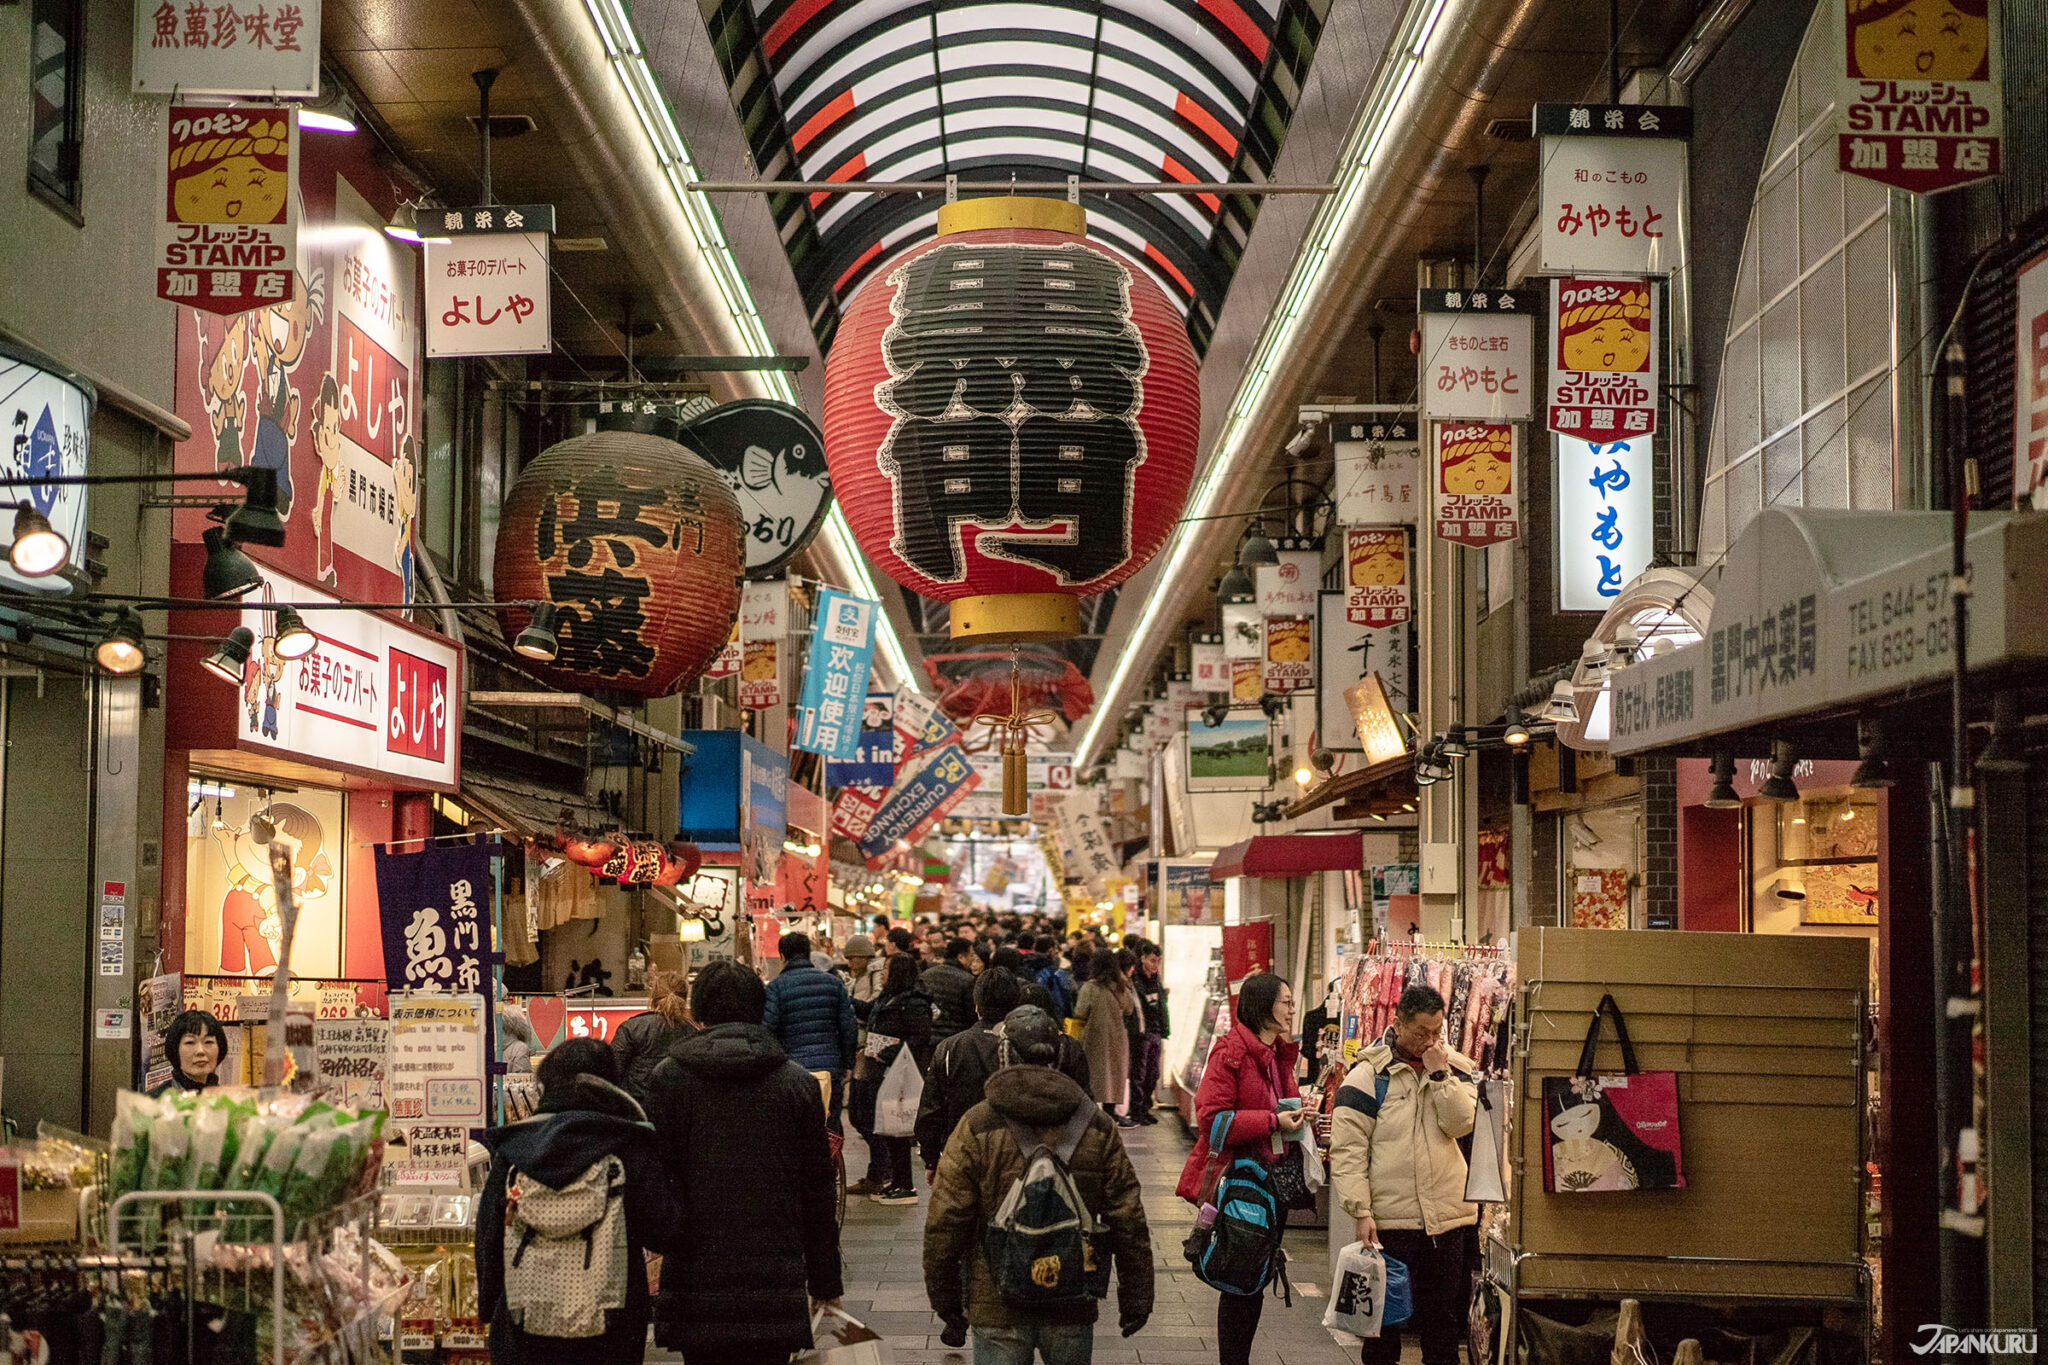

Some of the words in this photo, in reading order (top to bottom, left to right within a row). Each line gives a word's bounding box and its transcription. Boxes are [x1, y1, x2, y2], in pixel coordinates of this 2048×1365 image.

[151, 2, 304, 51] 魚萬珍味堂
[1860, 81, 1971, 103] フレッシュ
[172, 112, 249, 138] クロモン
[1849, 104, 1990, 134] STAMP
[1849, 139, 1991, 171] 加盟店
[1574, 168, 1647, 184] 和のこもの
[1556, 203, 1664, 238] みやもと
[177, 225, 272, 243] フレッシュ
[166, 244, 286, 267] STAMP
[446, 260, 527, 278] お菓子のデパート
[167, 272, 287, 298] 加盟店
[1561, 286, 1620, 304] クロモン
[442, 295, 535, 327] よしや
[1449, 336, 1508, 351] きものと宝石
[1438, 366, 1518, 394] みやもと
[1565, 372, 1638, 387] フレッシュ
[340, 336, 405, 458] よしや
[1557, 387, 1648, 404] STAMP
[1556, 408, 1647, 431] 加盟店
[1442, 429, 1489, 444] クロモン
[349, 469, 394, 526] 黒門市場店
[1447, 495, 1503, 506] フレッシュ
[1441, 506, 1512, 519] STAMP
[1351, 533, 1386, 546] クロモン
[1441, 521, 1513, 537] 加盟店
[1350, 595, 1405, 606] STAMP
[1848, 598, 1877, 634] TEL
[1881, 562, 1973, 626] 644-57
[1350, 609, 1407, 620] 加盟店
[1711, 593, 1817, 705] 黒門中央薬局
[1849, 638, 1877, 678] FAX
[1881, 616, 1970, 668] 633-08
[299, 653, 378, 714] お菓子のデパート
[1268, 669, 1310, 677] STAMP
[390, 663, 446, 751] よしや
[812, 645, 855, 752] 欢迎使用
[863, 781, 927, 843] EXCHANGE
[884, 784, 947, 846] CURRENCY
[393, 1008, 478, 1019] 表示価格について
